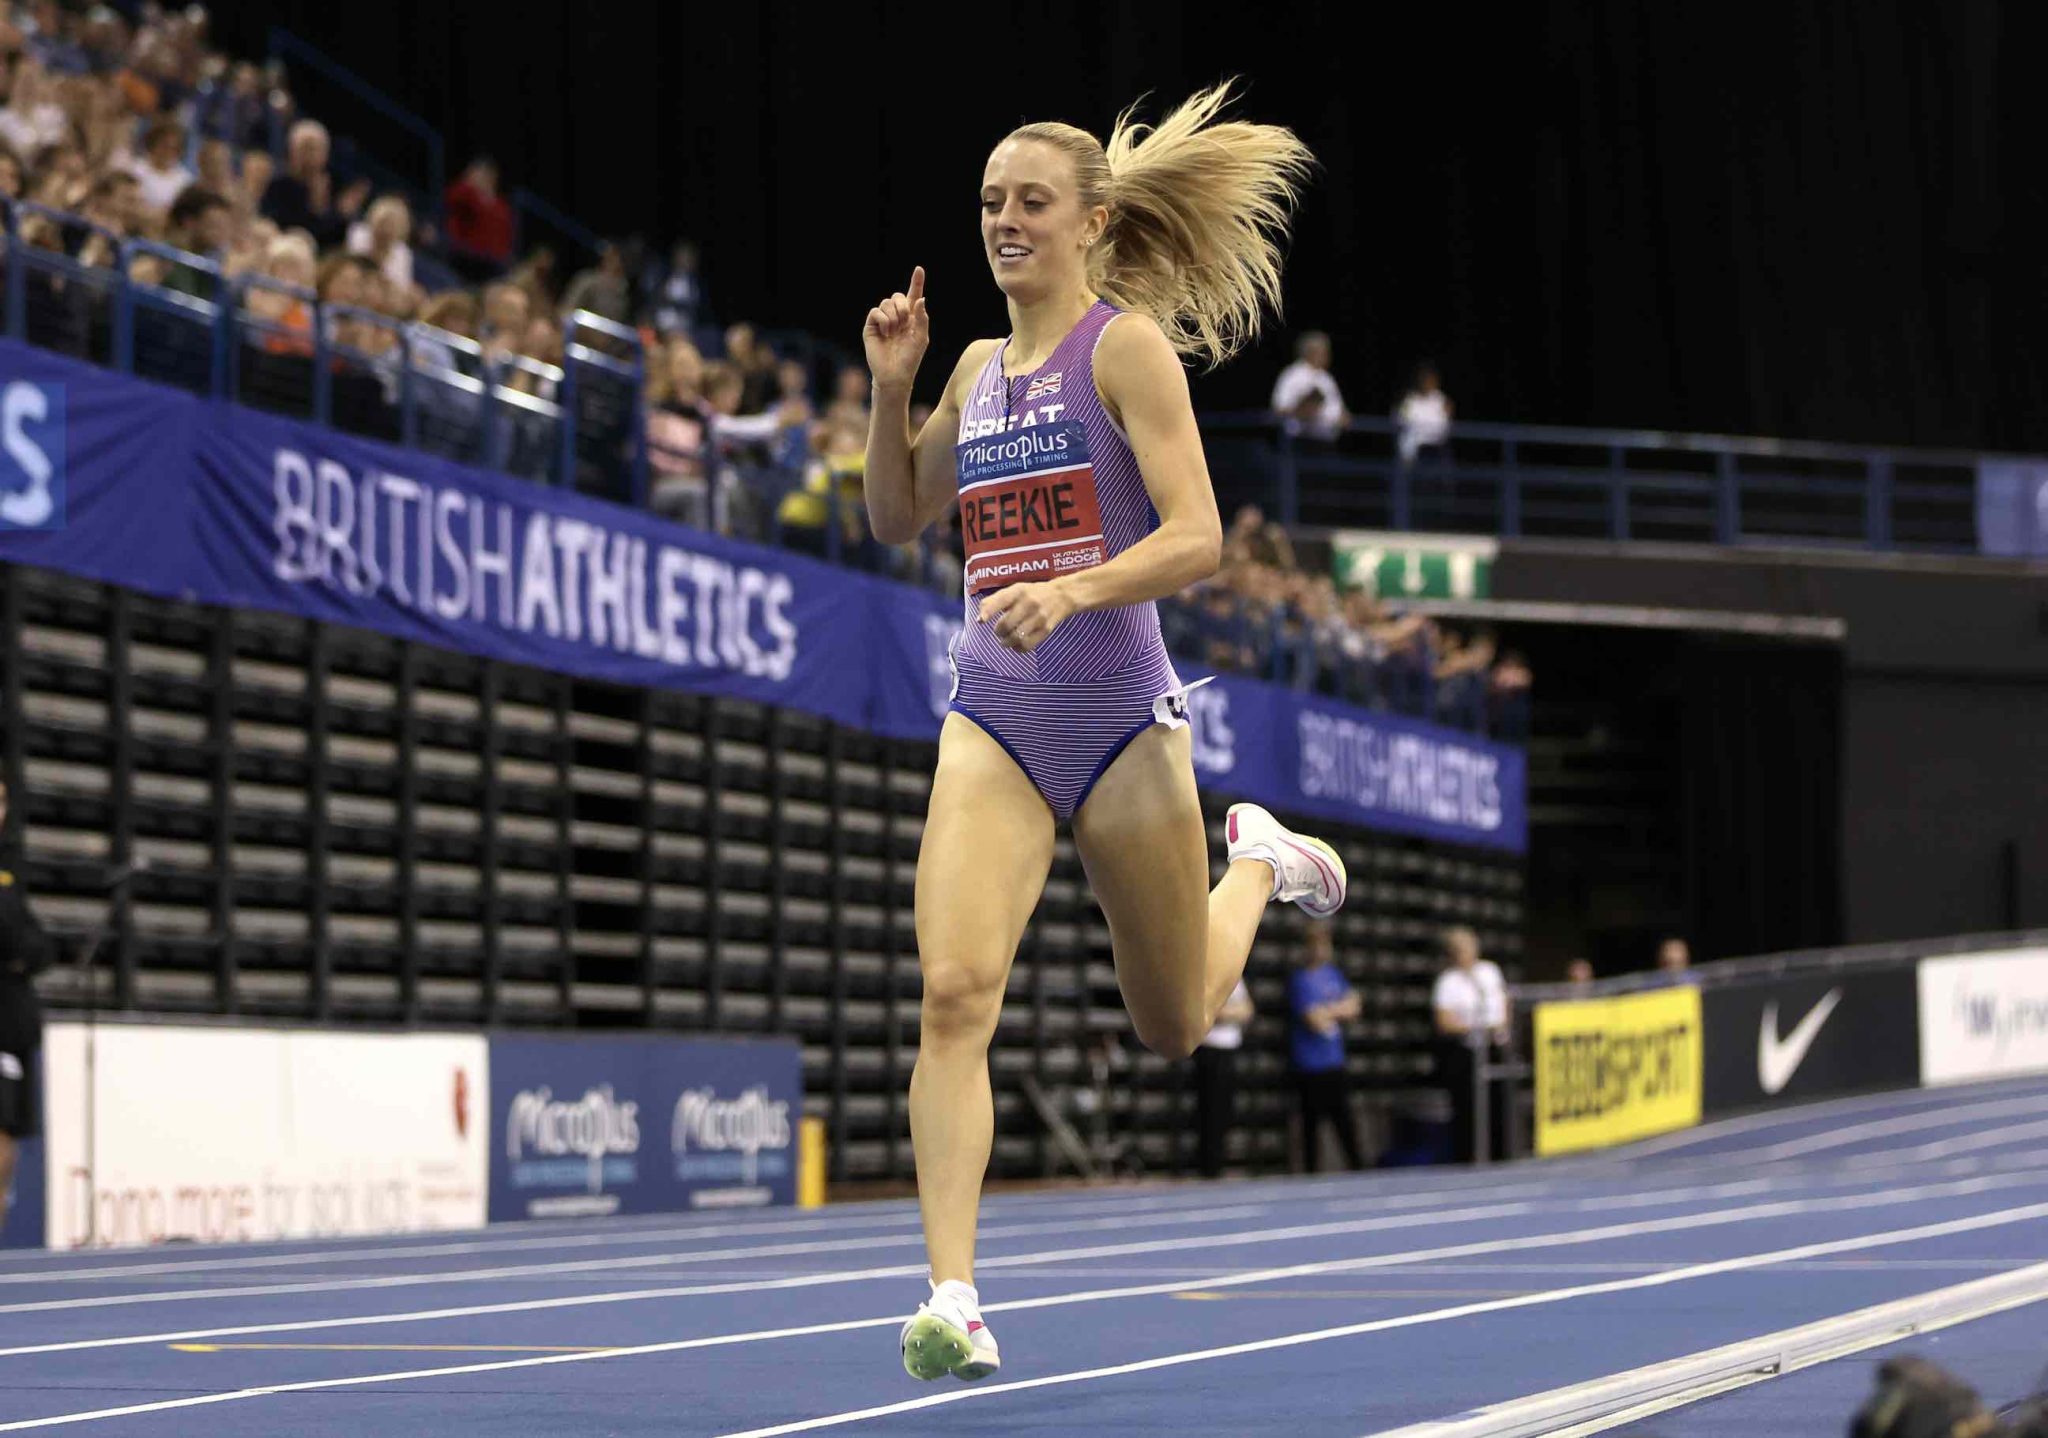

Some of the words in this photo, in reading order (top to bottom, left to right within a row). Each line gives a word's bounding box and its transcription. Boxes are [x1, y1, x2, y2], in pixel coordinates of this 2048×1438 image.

[977, 460, 1021, 475] PROCESSING
[1034, 452, 1068, 464] TIMING
[965, 482, 1080, 545] REEKIE
[1053, 551, 1101, 567] INDOOR
